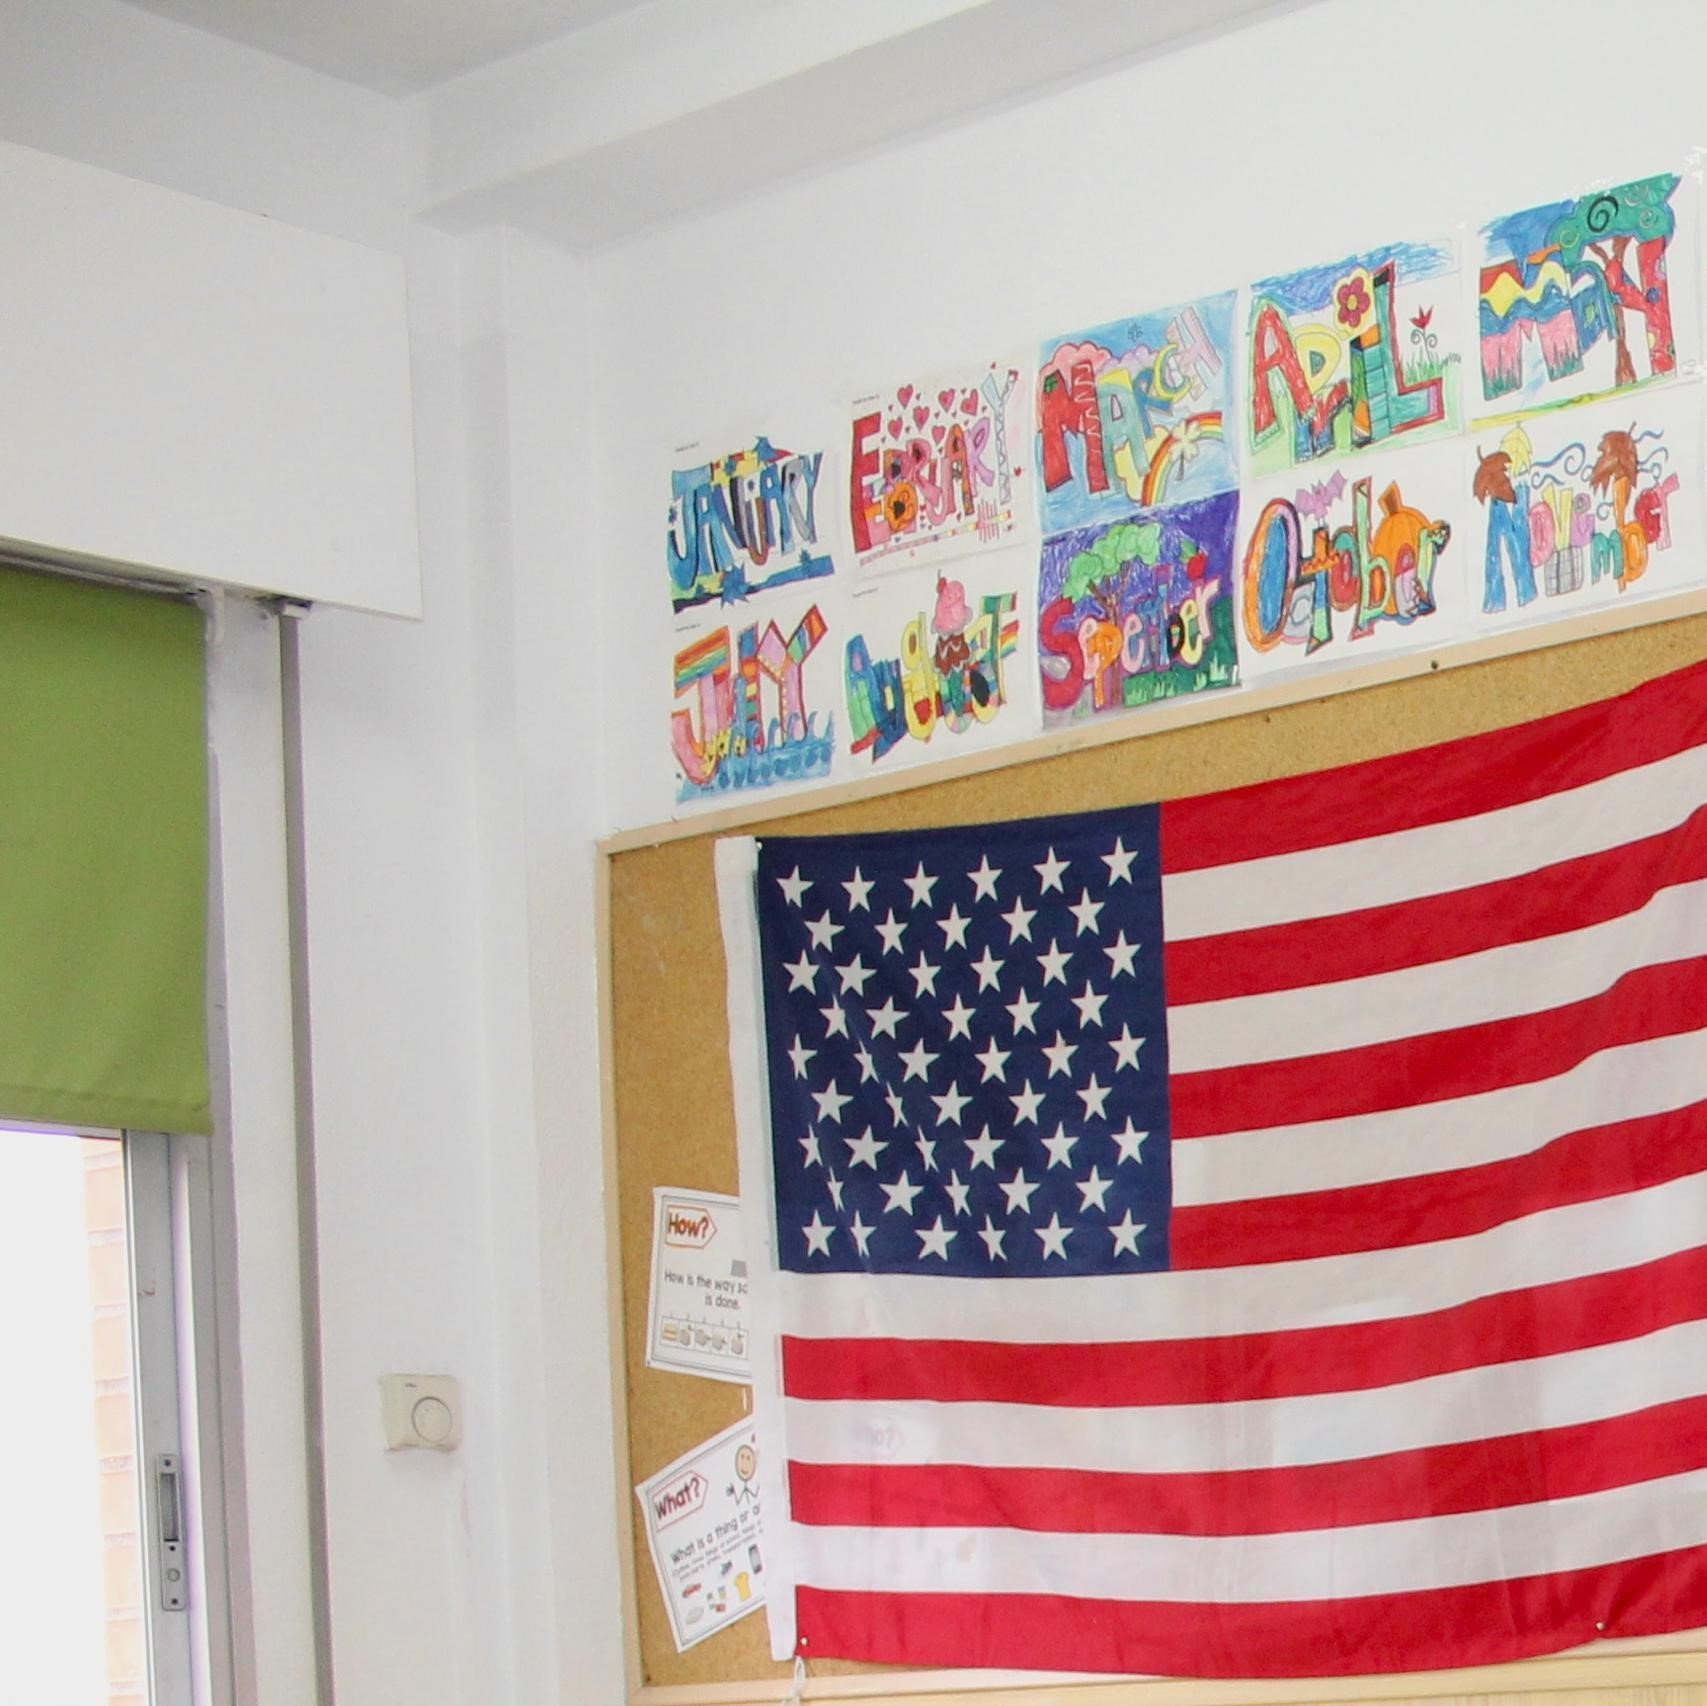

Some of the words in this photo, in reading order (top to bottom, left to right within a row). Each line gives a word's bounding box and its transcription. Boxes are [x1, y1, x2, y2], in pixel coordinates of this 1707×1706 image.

[1040, 305, 1222, 494] MARCH
[667, 451, 823, 590] JANUARY
[668, 1212, 709, 1240] How?
[656, 1477, 700, 1520] What?
